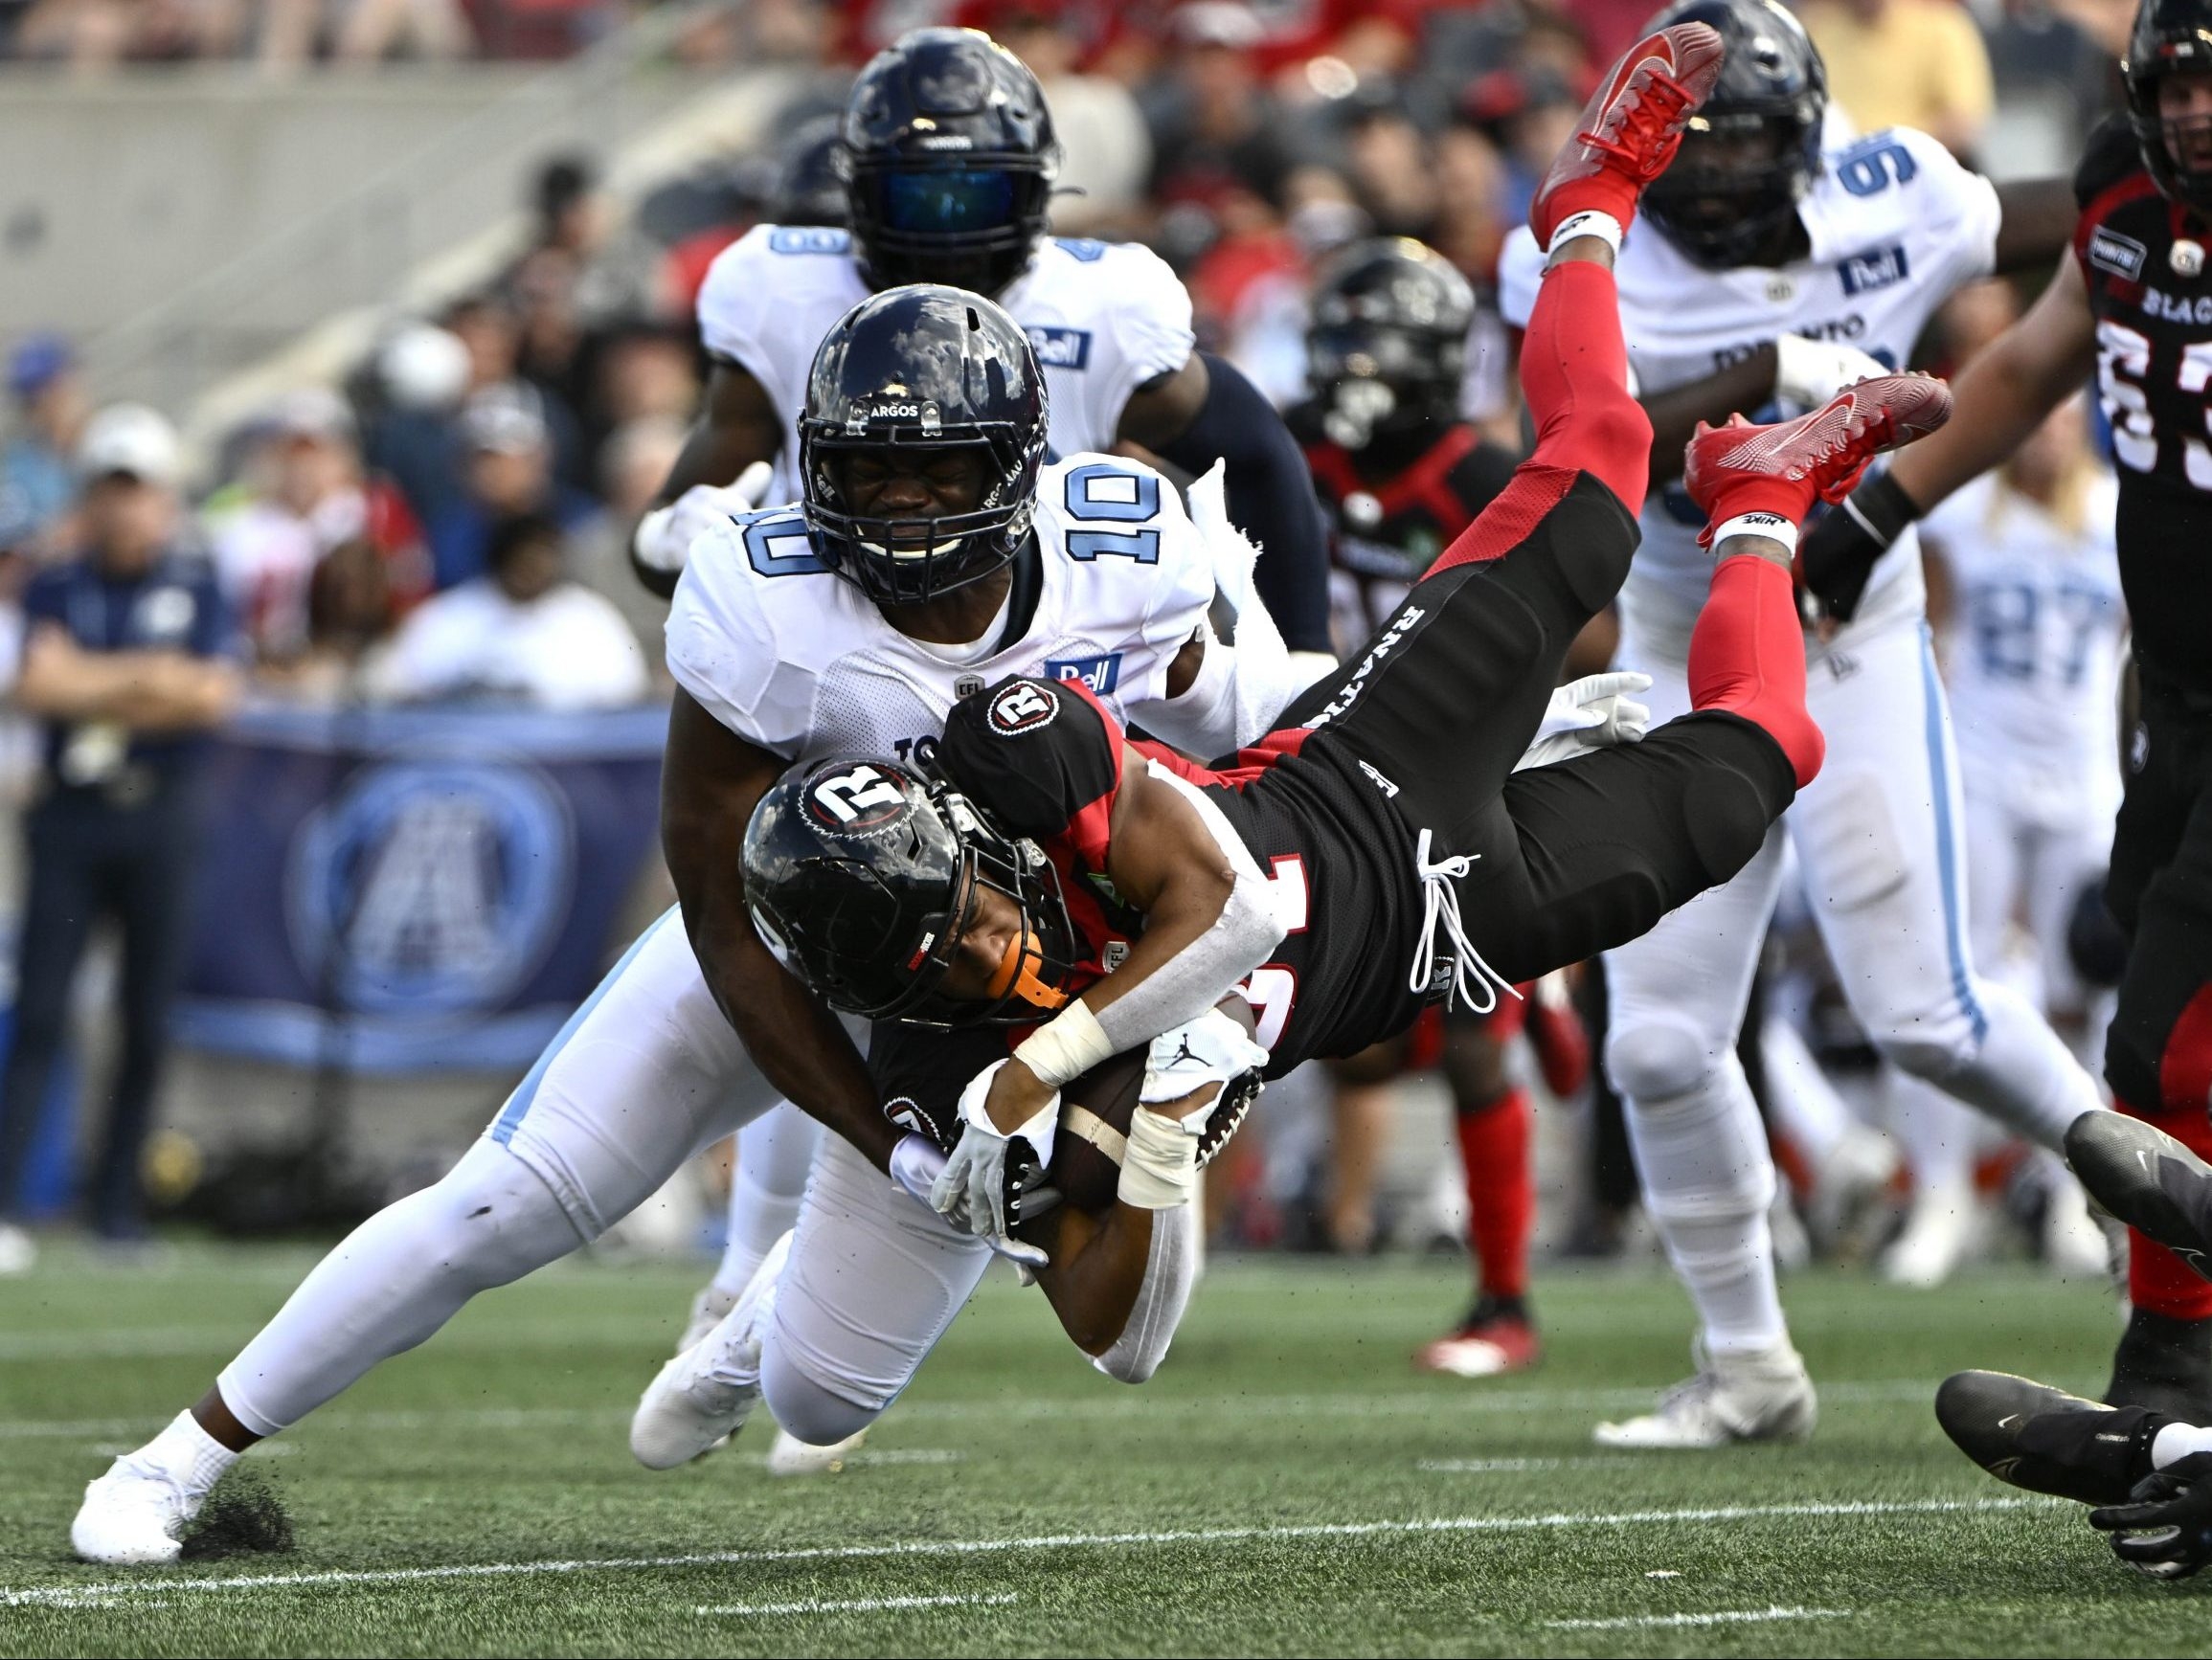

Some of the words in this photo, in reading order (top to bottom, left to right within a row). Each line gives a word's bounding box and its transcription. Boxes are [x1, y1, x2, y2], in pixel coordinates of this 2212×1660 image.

[870, 405, 918, 417] ARGOS
[1064, 463, 1161, 565] 10
[1742, 515, 1778, 526] NIKE
[996, 685, 1050, 726] R
[815, 765, 906, 823] R
